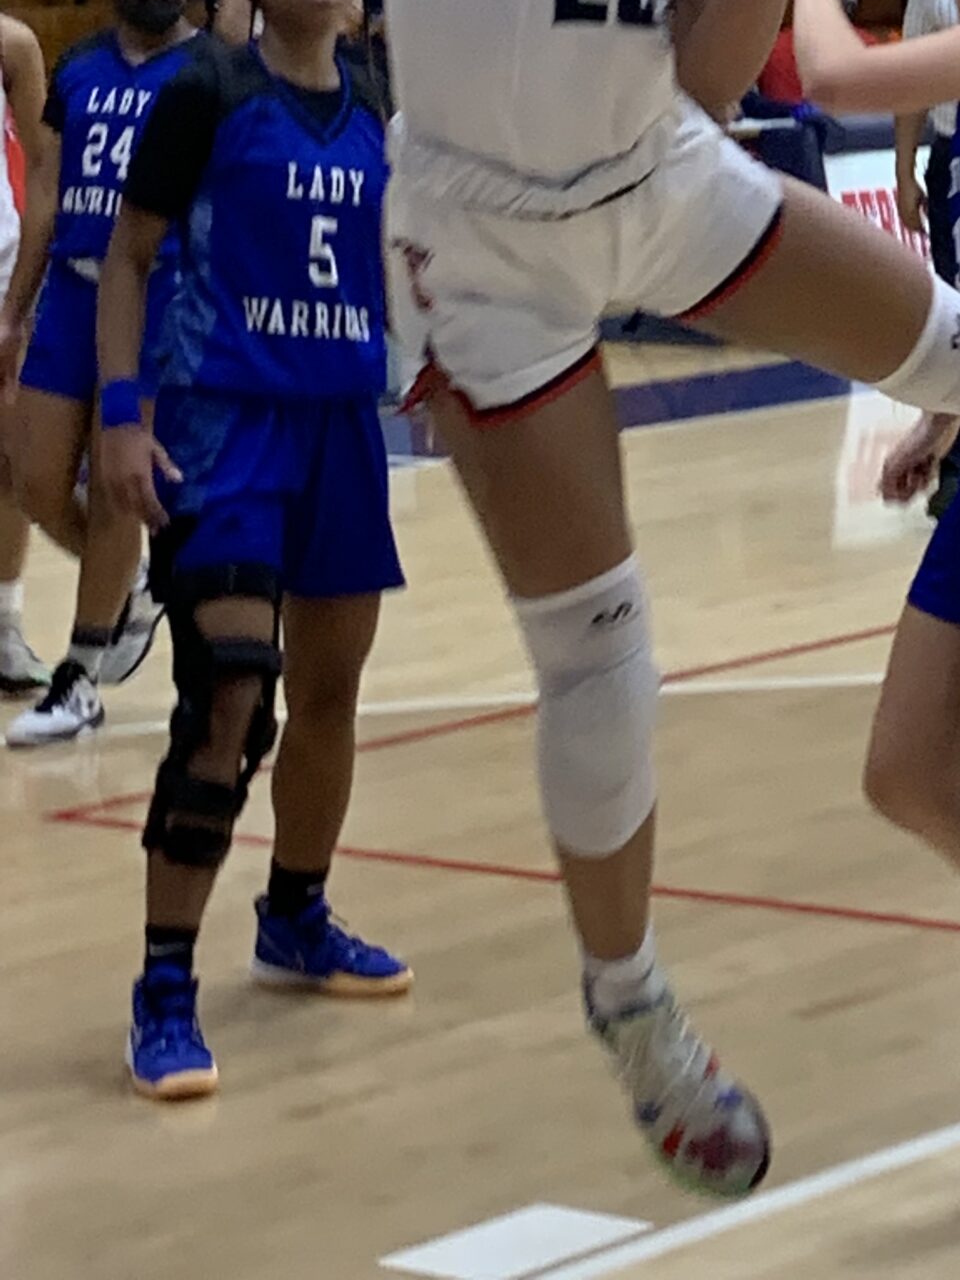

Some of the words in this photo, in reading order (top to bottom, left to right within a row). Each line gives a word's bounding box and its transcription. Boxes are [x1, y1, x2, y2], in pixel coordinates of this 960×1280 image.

[86, 86, 152, 118] LADY
[81, 122, 135, 182] 24
[286, 161, 364, 207] LADY
[308, 215, 339, 288] 5
